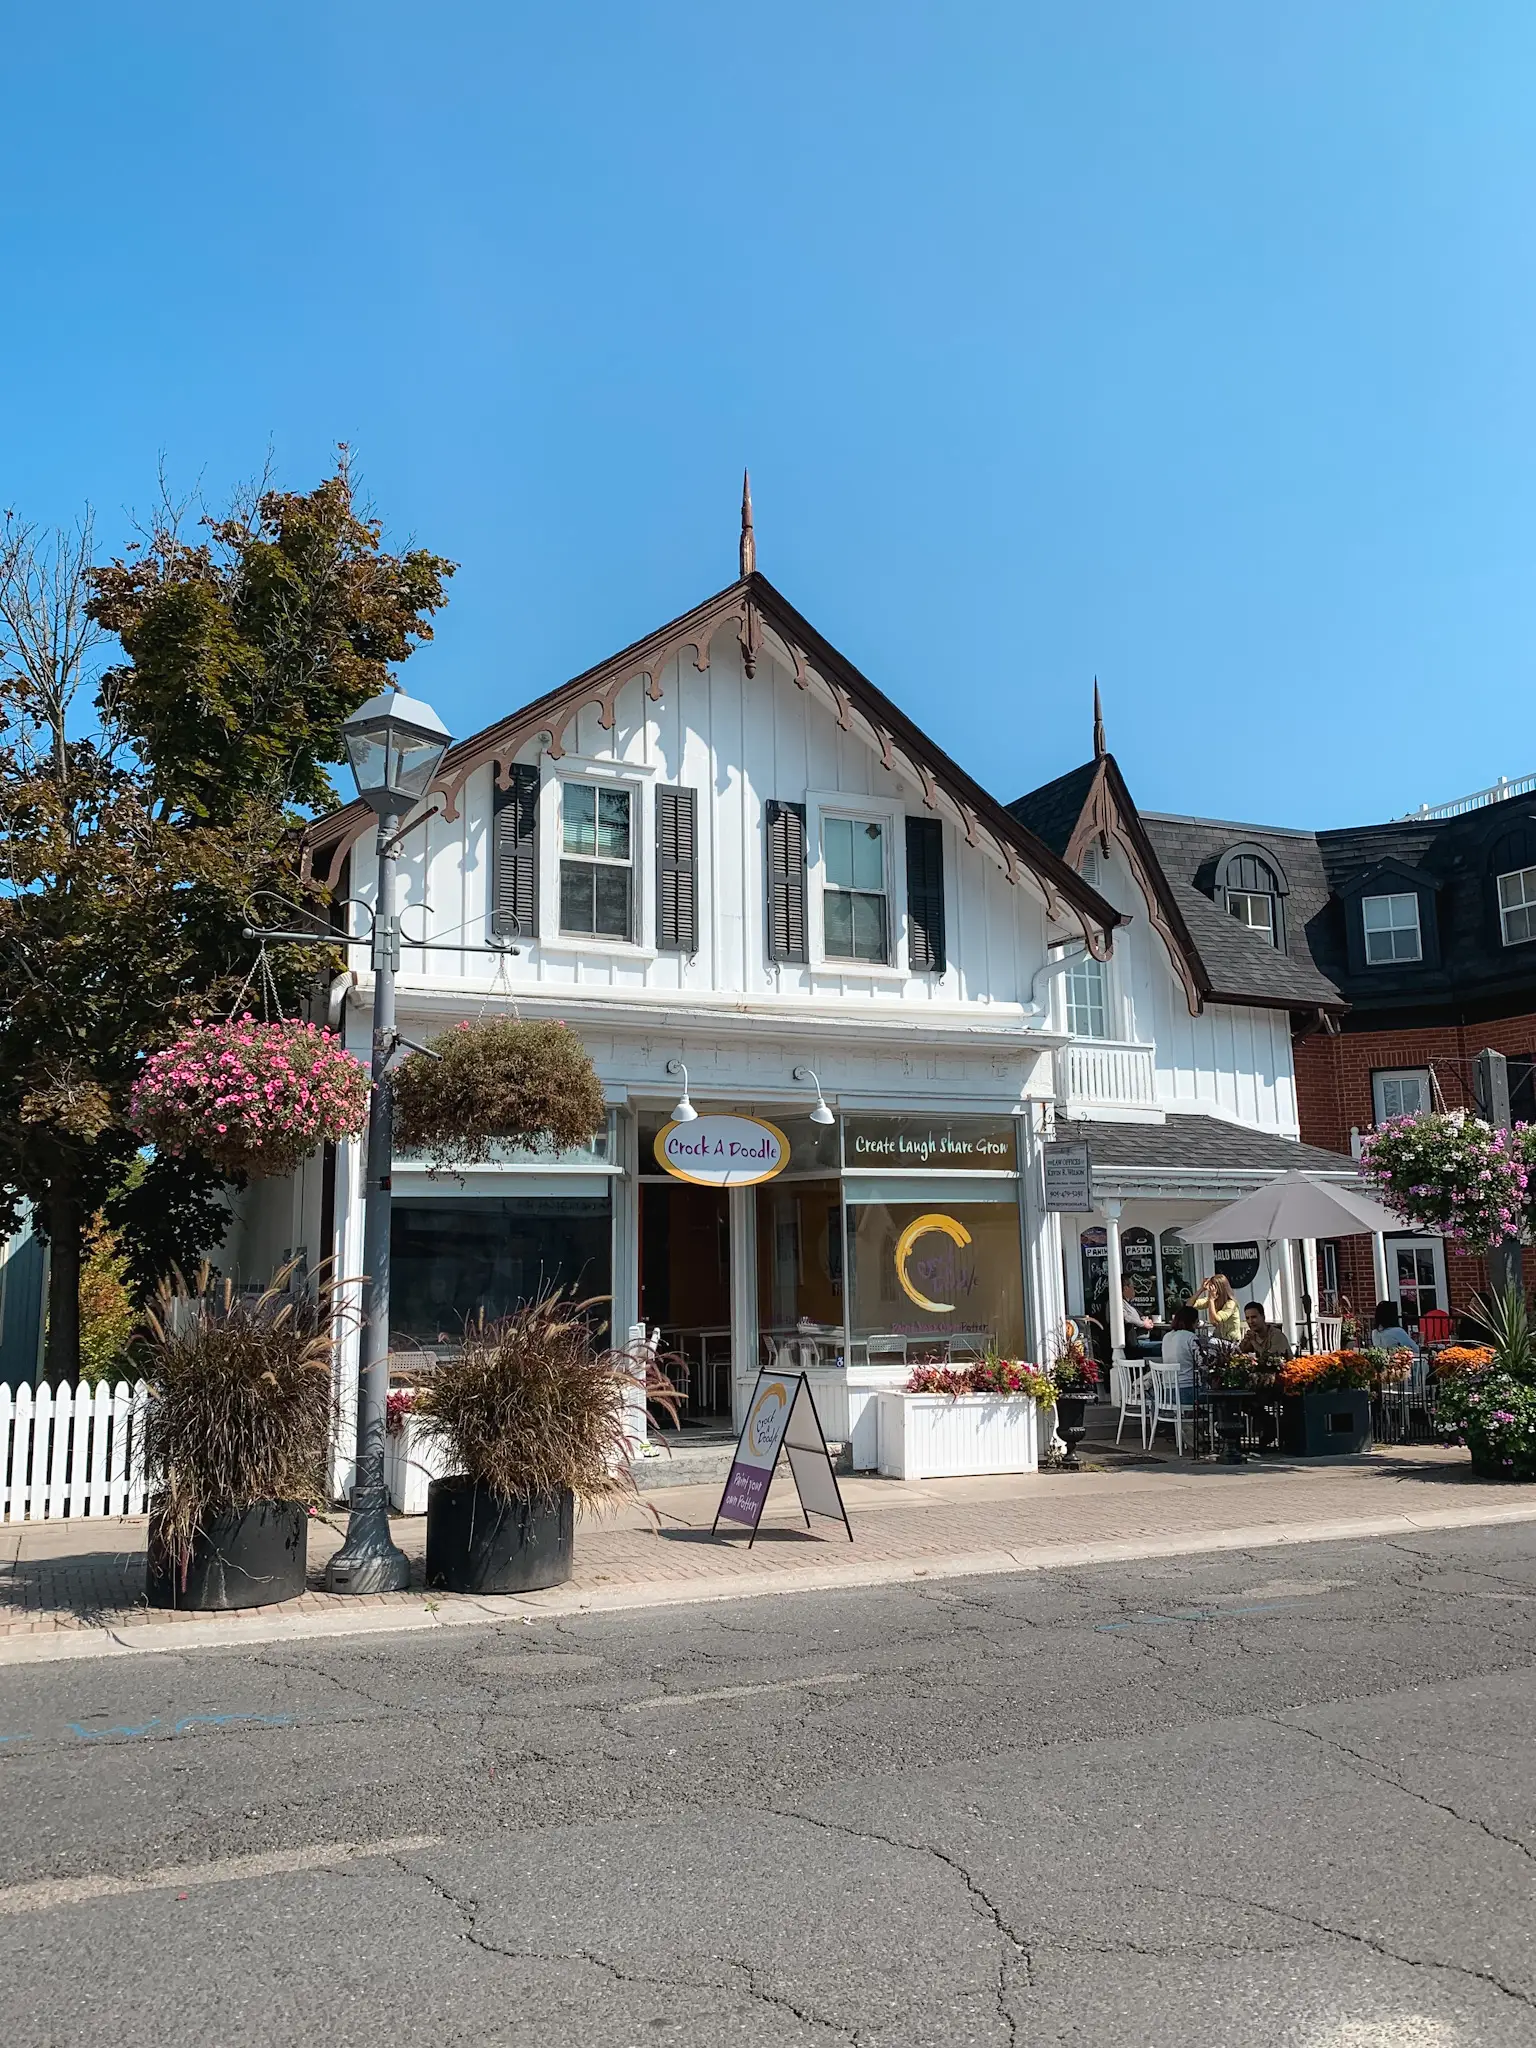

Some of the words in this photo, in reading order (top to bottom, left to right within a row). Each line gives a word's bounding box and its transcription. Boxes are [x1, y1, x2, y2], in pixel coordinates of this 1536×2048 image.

[668, 1135, 710, 1157] Crock
[713, 1139, 725, 1156] A
[728, 1138, 777, 1160] Doodle
[855, 1135, 896, 1154] Create
[899, 1131, 936, 1162] Laugh
[939, 1131, 973, 1154] Share
[975, 1138, 1009, 1155] Grow
[1126, 1246, 1152, 1256] PASTA
[1231, 1248, 1258, 1260] KRUNCH
[733, 1472, 750, 1490] Paint
[747, 1479, 763, 1496] your
[737, 1494, 759, 1520] Pottery
